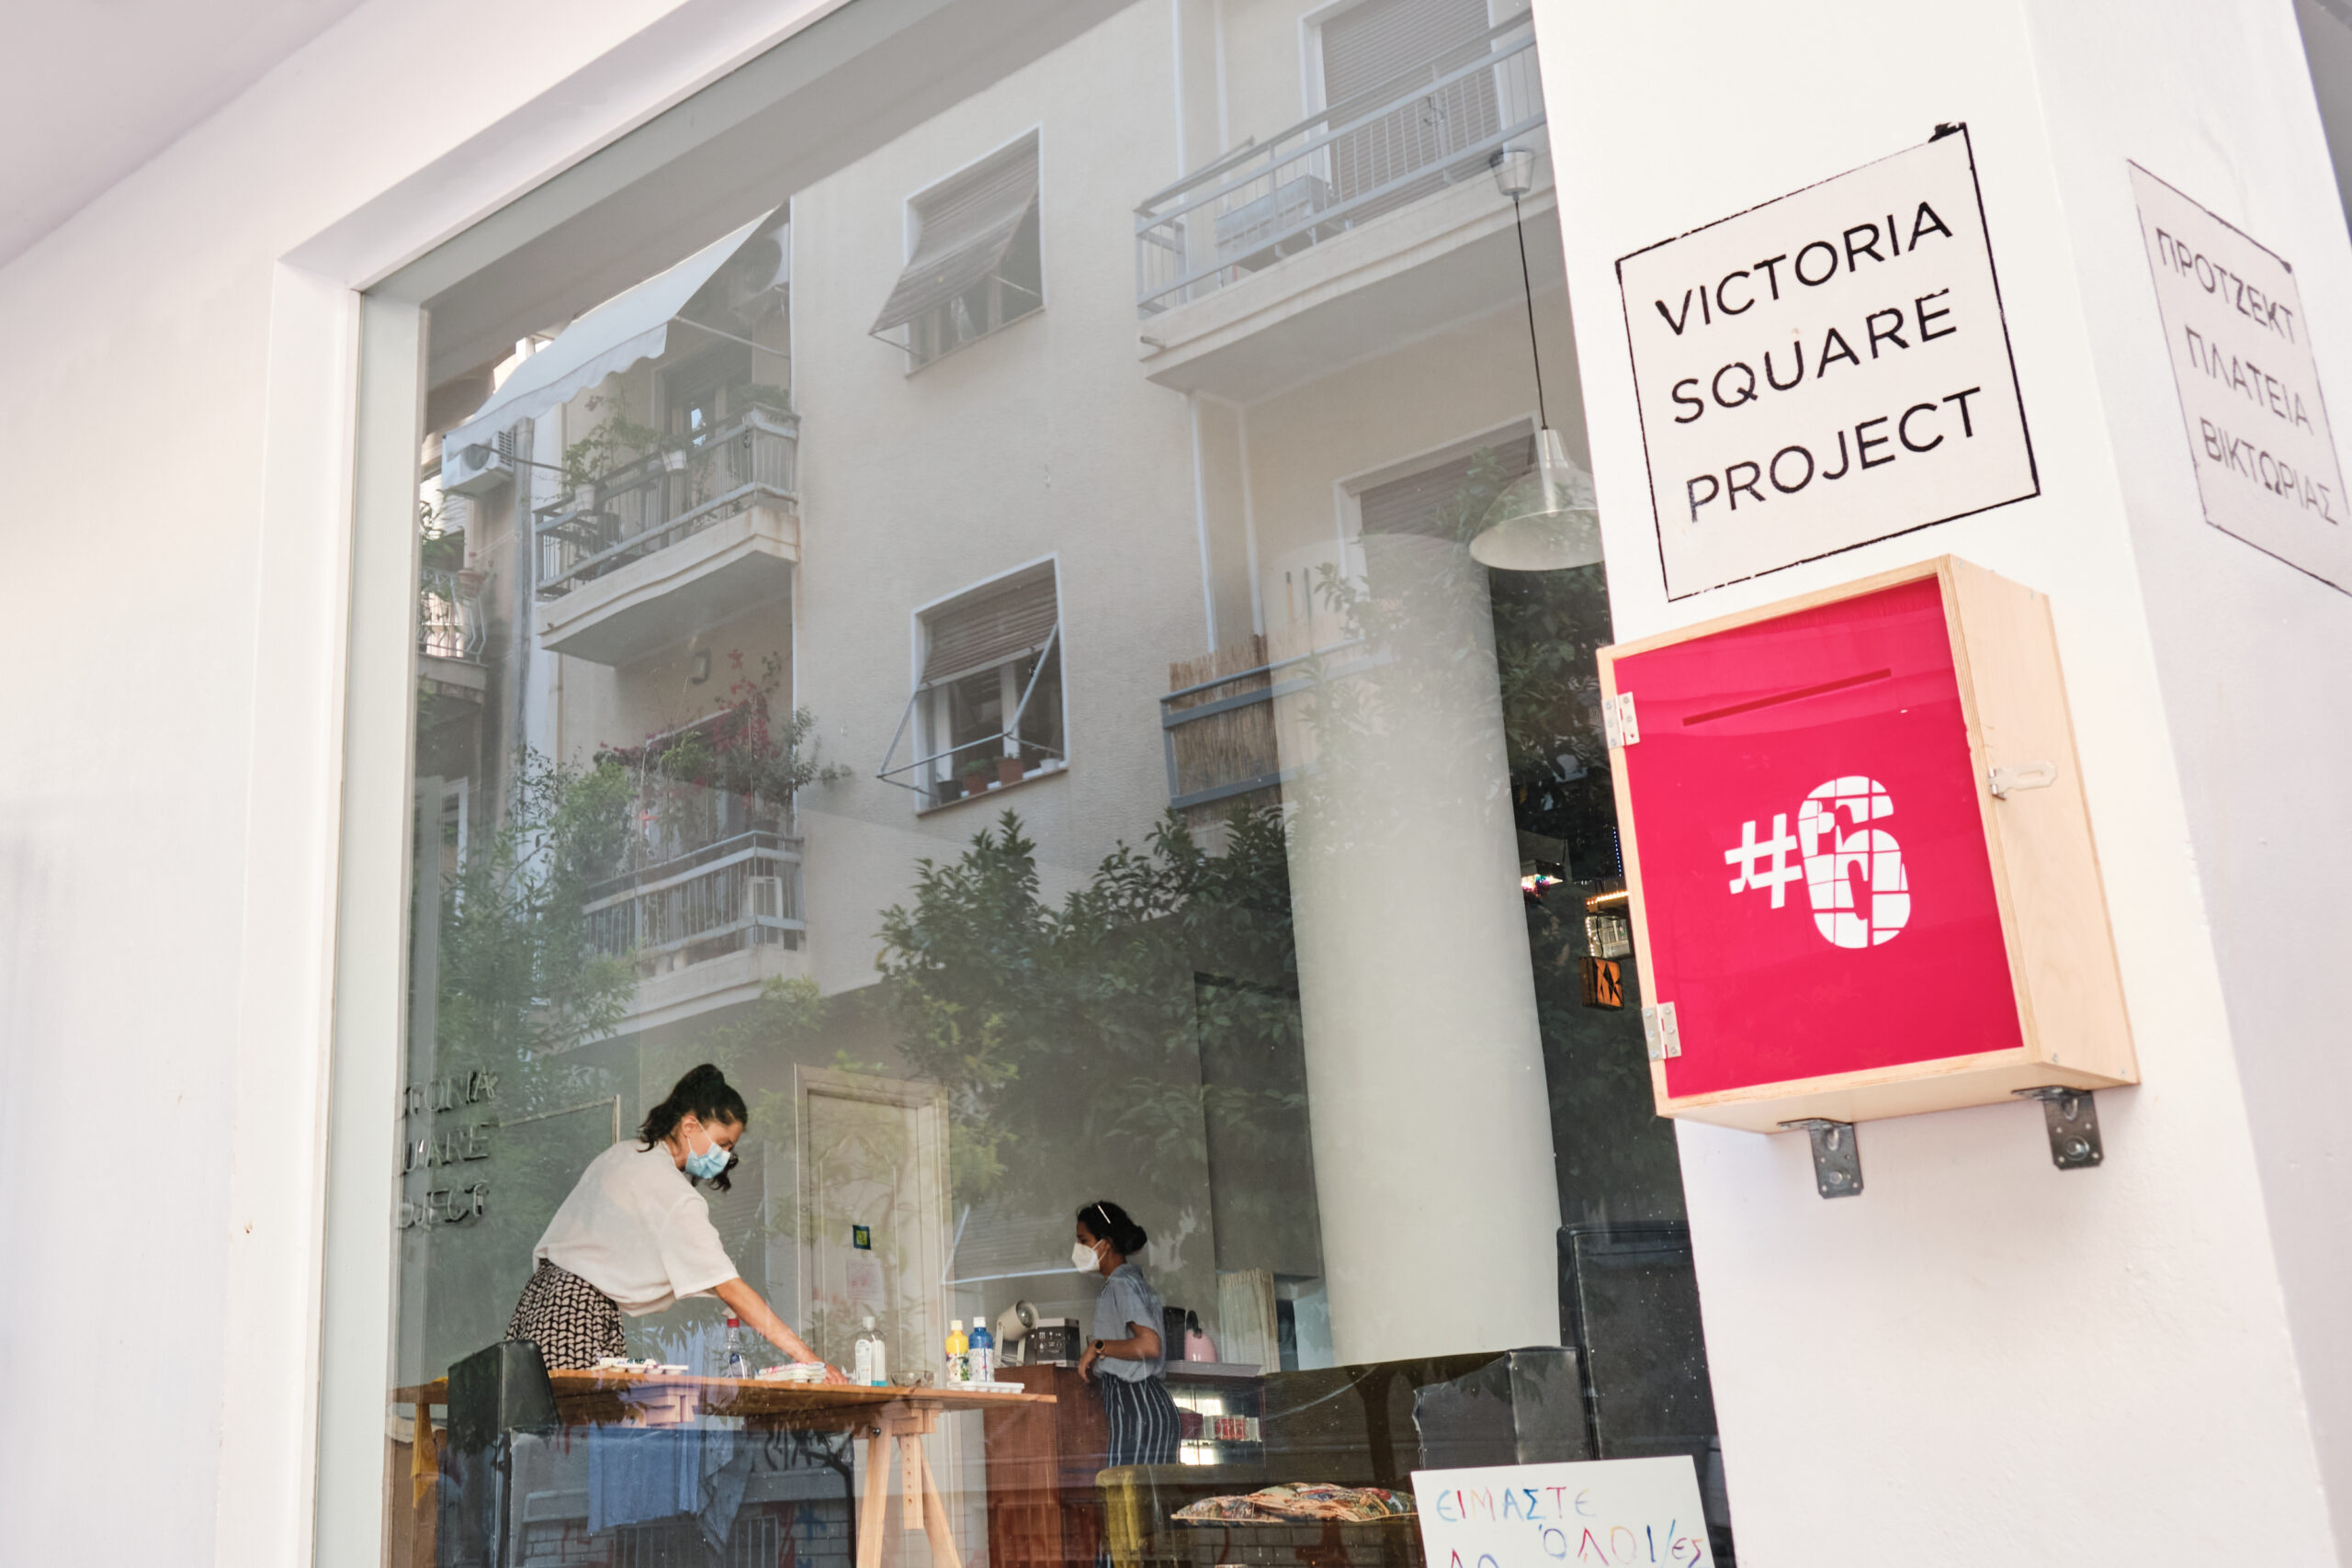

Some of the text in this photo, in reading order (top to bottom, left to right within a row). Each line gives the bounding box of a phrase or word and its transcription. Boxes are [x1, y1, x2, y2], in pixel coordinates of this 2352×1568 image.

[1655, 201, 1953, 336] VICTORIA
[2154, 226, 2296, 344] ΠΡΟΤΖΕΚΤ
[1670, 288, 1958, 425] SQUARE
[2185, 324, 2315, 435] ΠΛΑΤΕΙΑ
[1685, 387, 1982, 524] PROJECT
[2200, 416, 2339, 526] ΒΙΚΤΩΡΙΑΣ
[1436, 1486, 1598, 1522] ΕΙΜΑΣΤΕ
